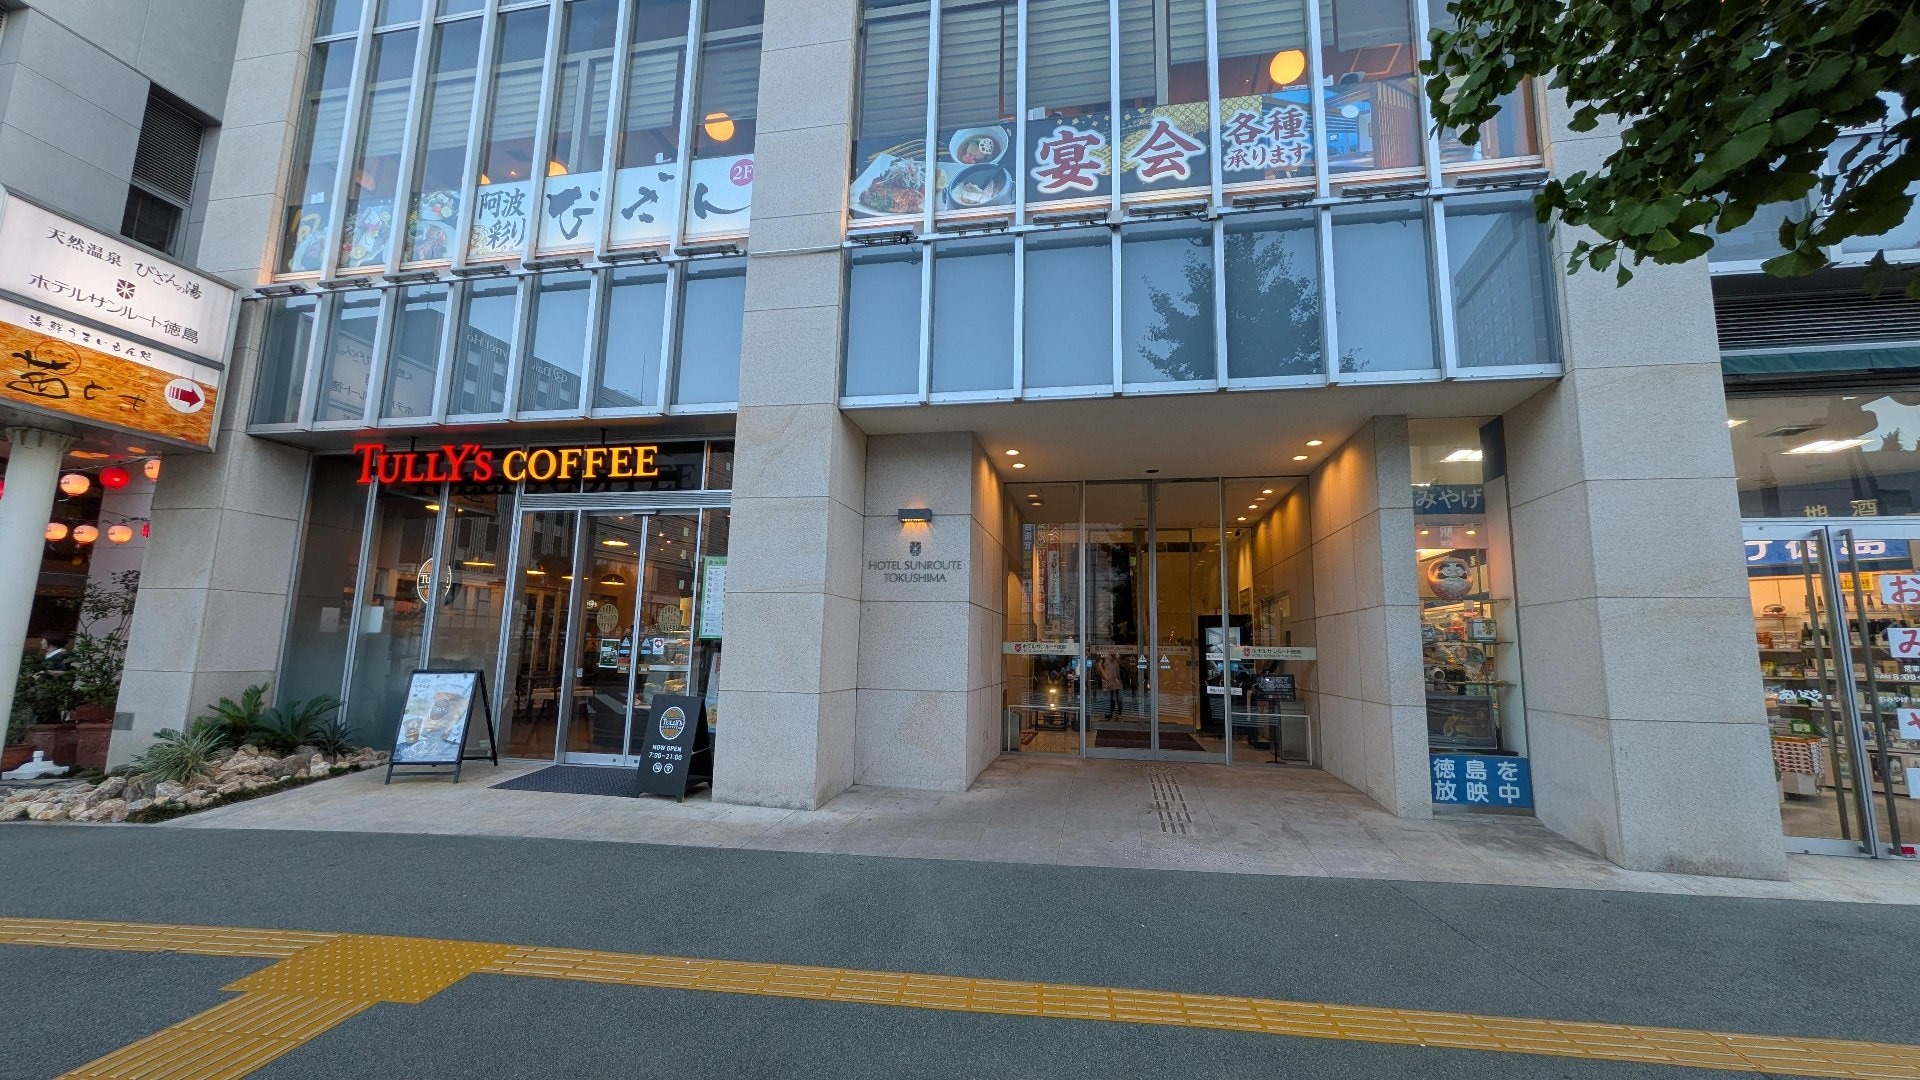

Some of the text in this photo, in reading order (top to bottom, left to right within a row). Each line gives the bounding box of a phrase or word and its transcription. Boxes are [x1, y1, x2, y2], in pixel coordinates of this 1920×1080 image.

[1226, 107, 1306, 145] 各種
[1036, 120, 1201, 189] 宴会
[1227, 142, 1309, 168] 承ります
[732, 165, 754, 181] 2F
[478, 187, 526, 220] 阿波
[488, 217, 526, 250] 彩り
[48, 226, 202, 300] 天然温泉 びざんの湯
[29, 273, 199, 344] ホテルサンルート徳島
[502, 445, 659, 481] COFFEE
[1415, 487, 1483, 509] みやげ
[1803, 499, 1878, 517] 地酒
[868, 560, 962, 570] HOTEL SUNROUTE
[884, 572, 947, 582] TOKUSHIMA
[1433, 758, 1519, 781] 徳島を
[1434, 780, 1521, 804] 放映中
